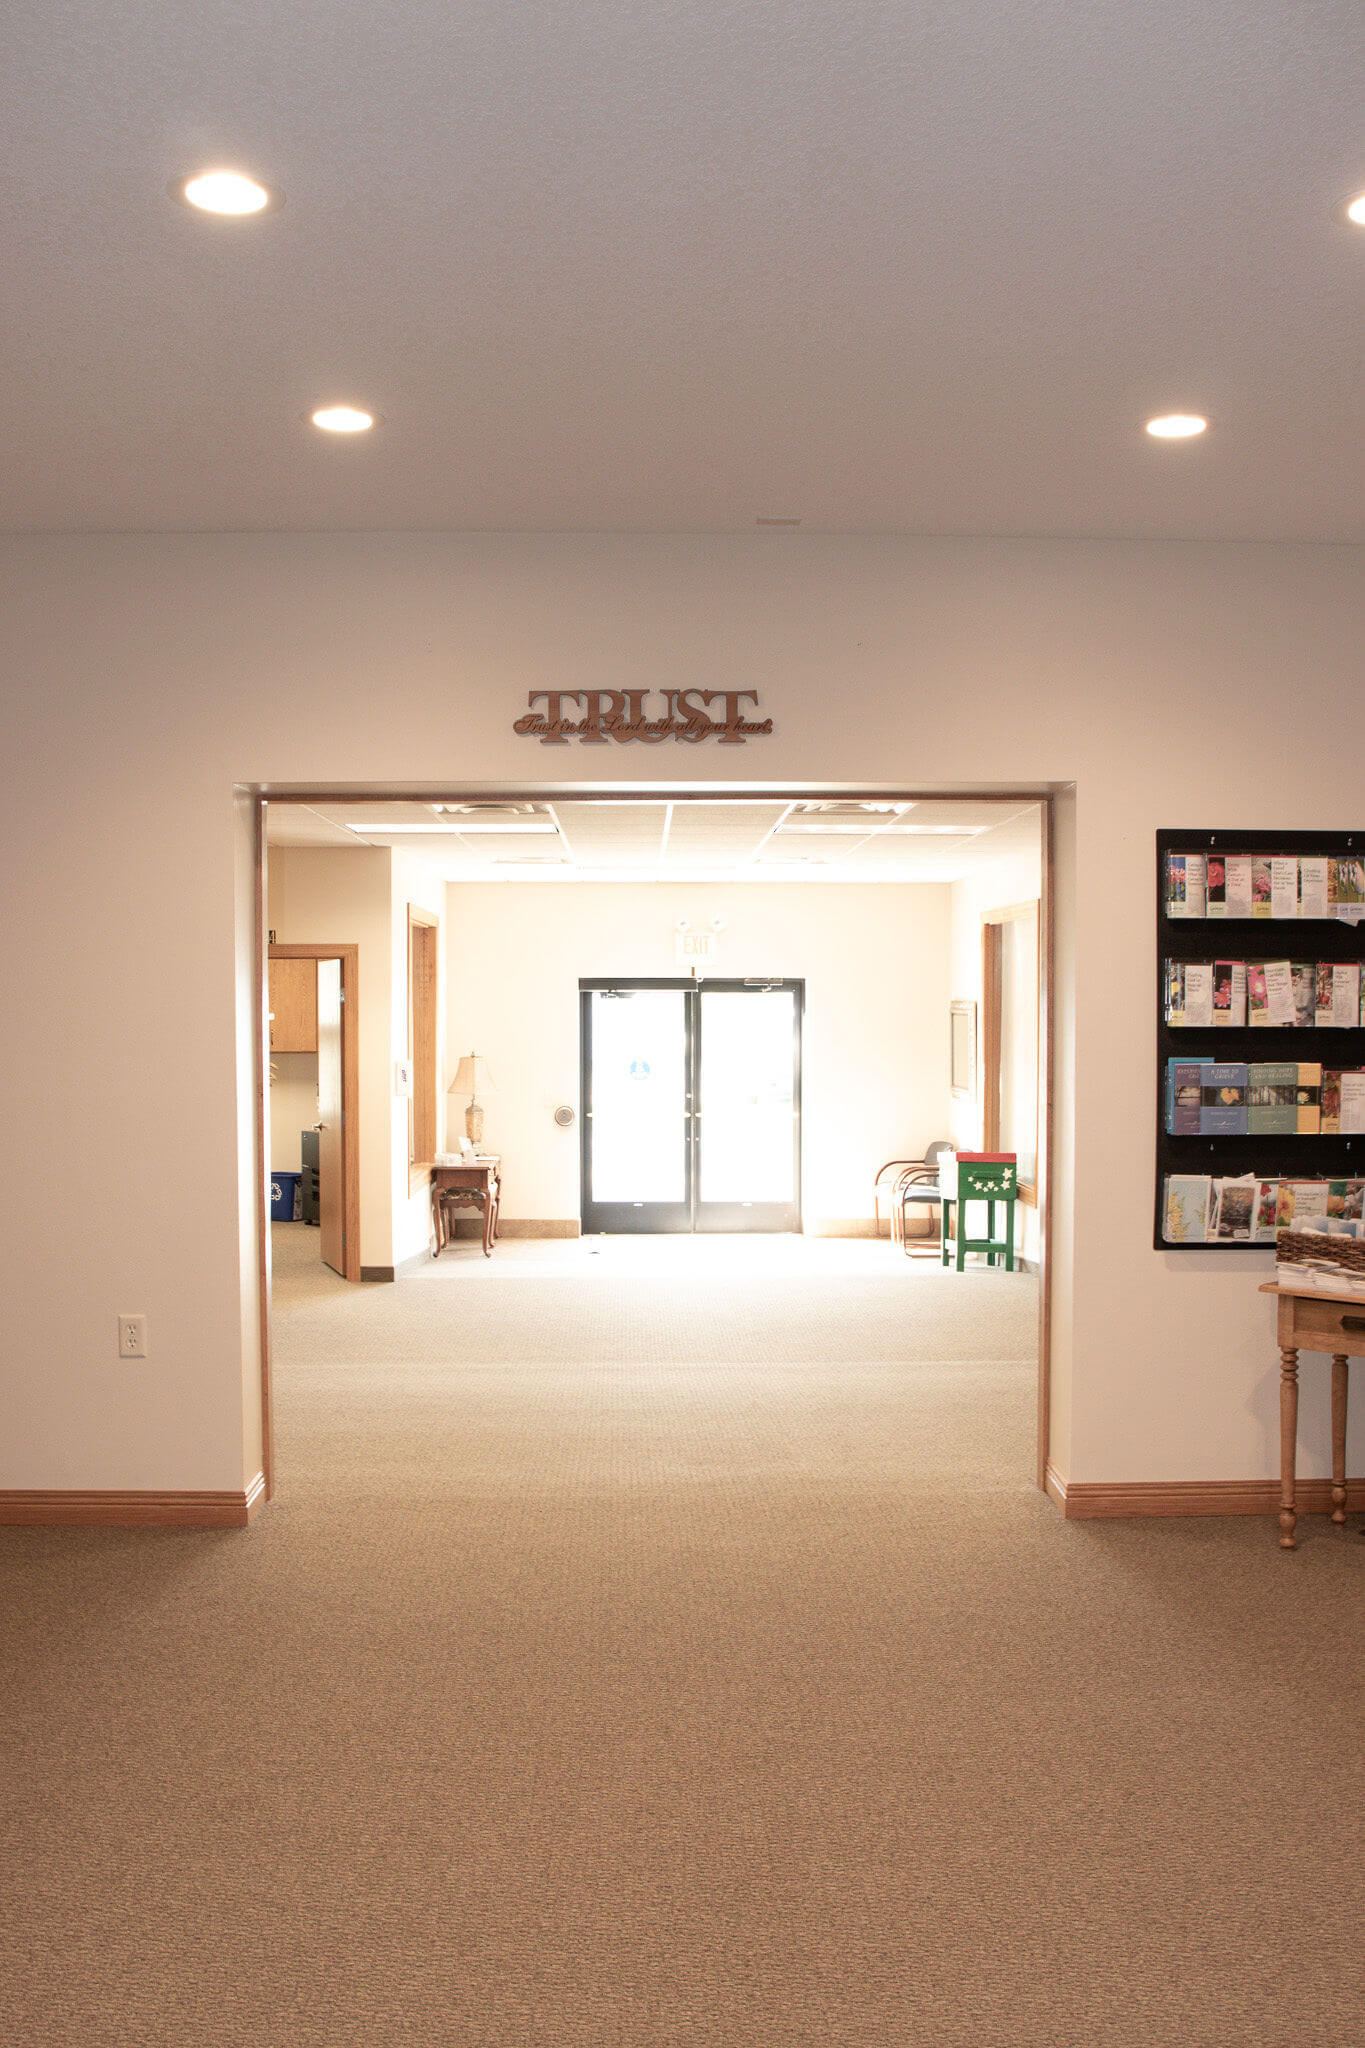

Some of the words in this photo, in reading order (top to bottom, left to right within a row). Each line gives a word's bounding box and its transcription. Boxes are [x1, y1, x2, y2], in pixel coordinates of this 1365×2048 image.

[515, 715, 558, 731] Trust
[559, 717, 576, 731] in
[577, 717, 599, 731] the
[604, 714, 645, 731] Lord
[645, 716, 672, 731] with
[675, 716, 698, 731] all
[699, 721, 731, 735] your
[528, 688, 758, 744] TRUST
[683, 935, 710, 954] EXIT
